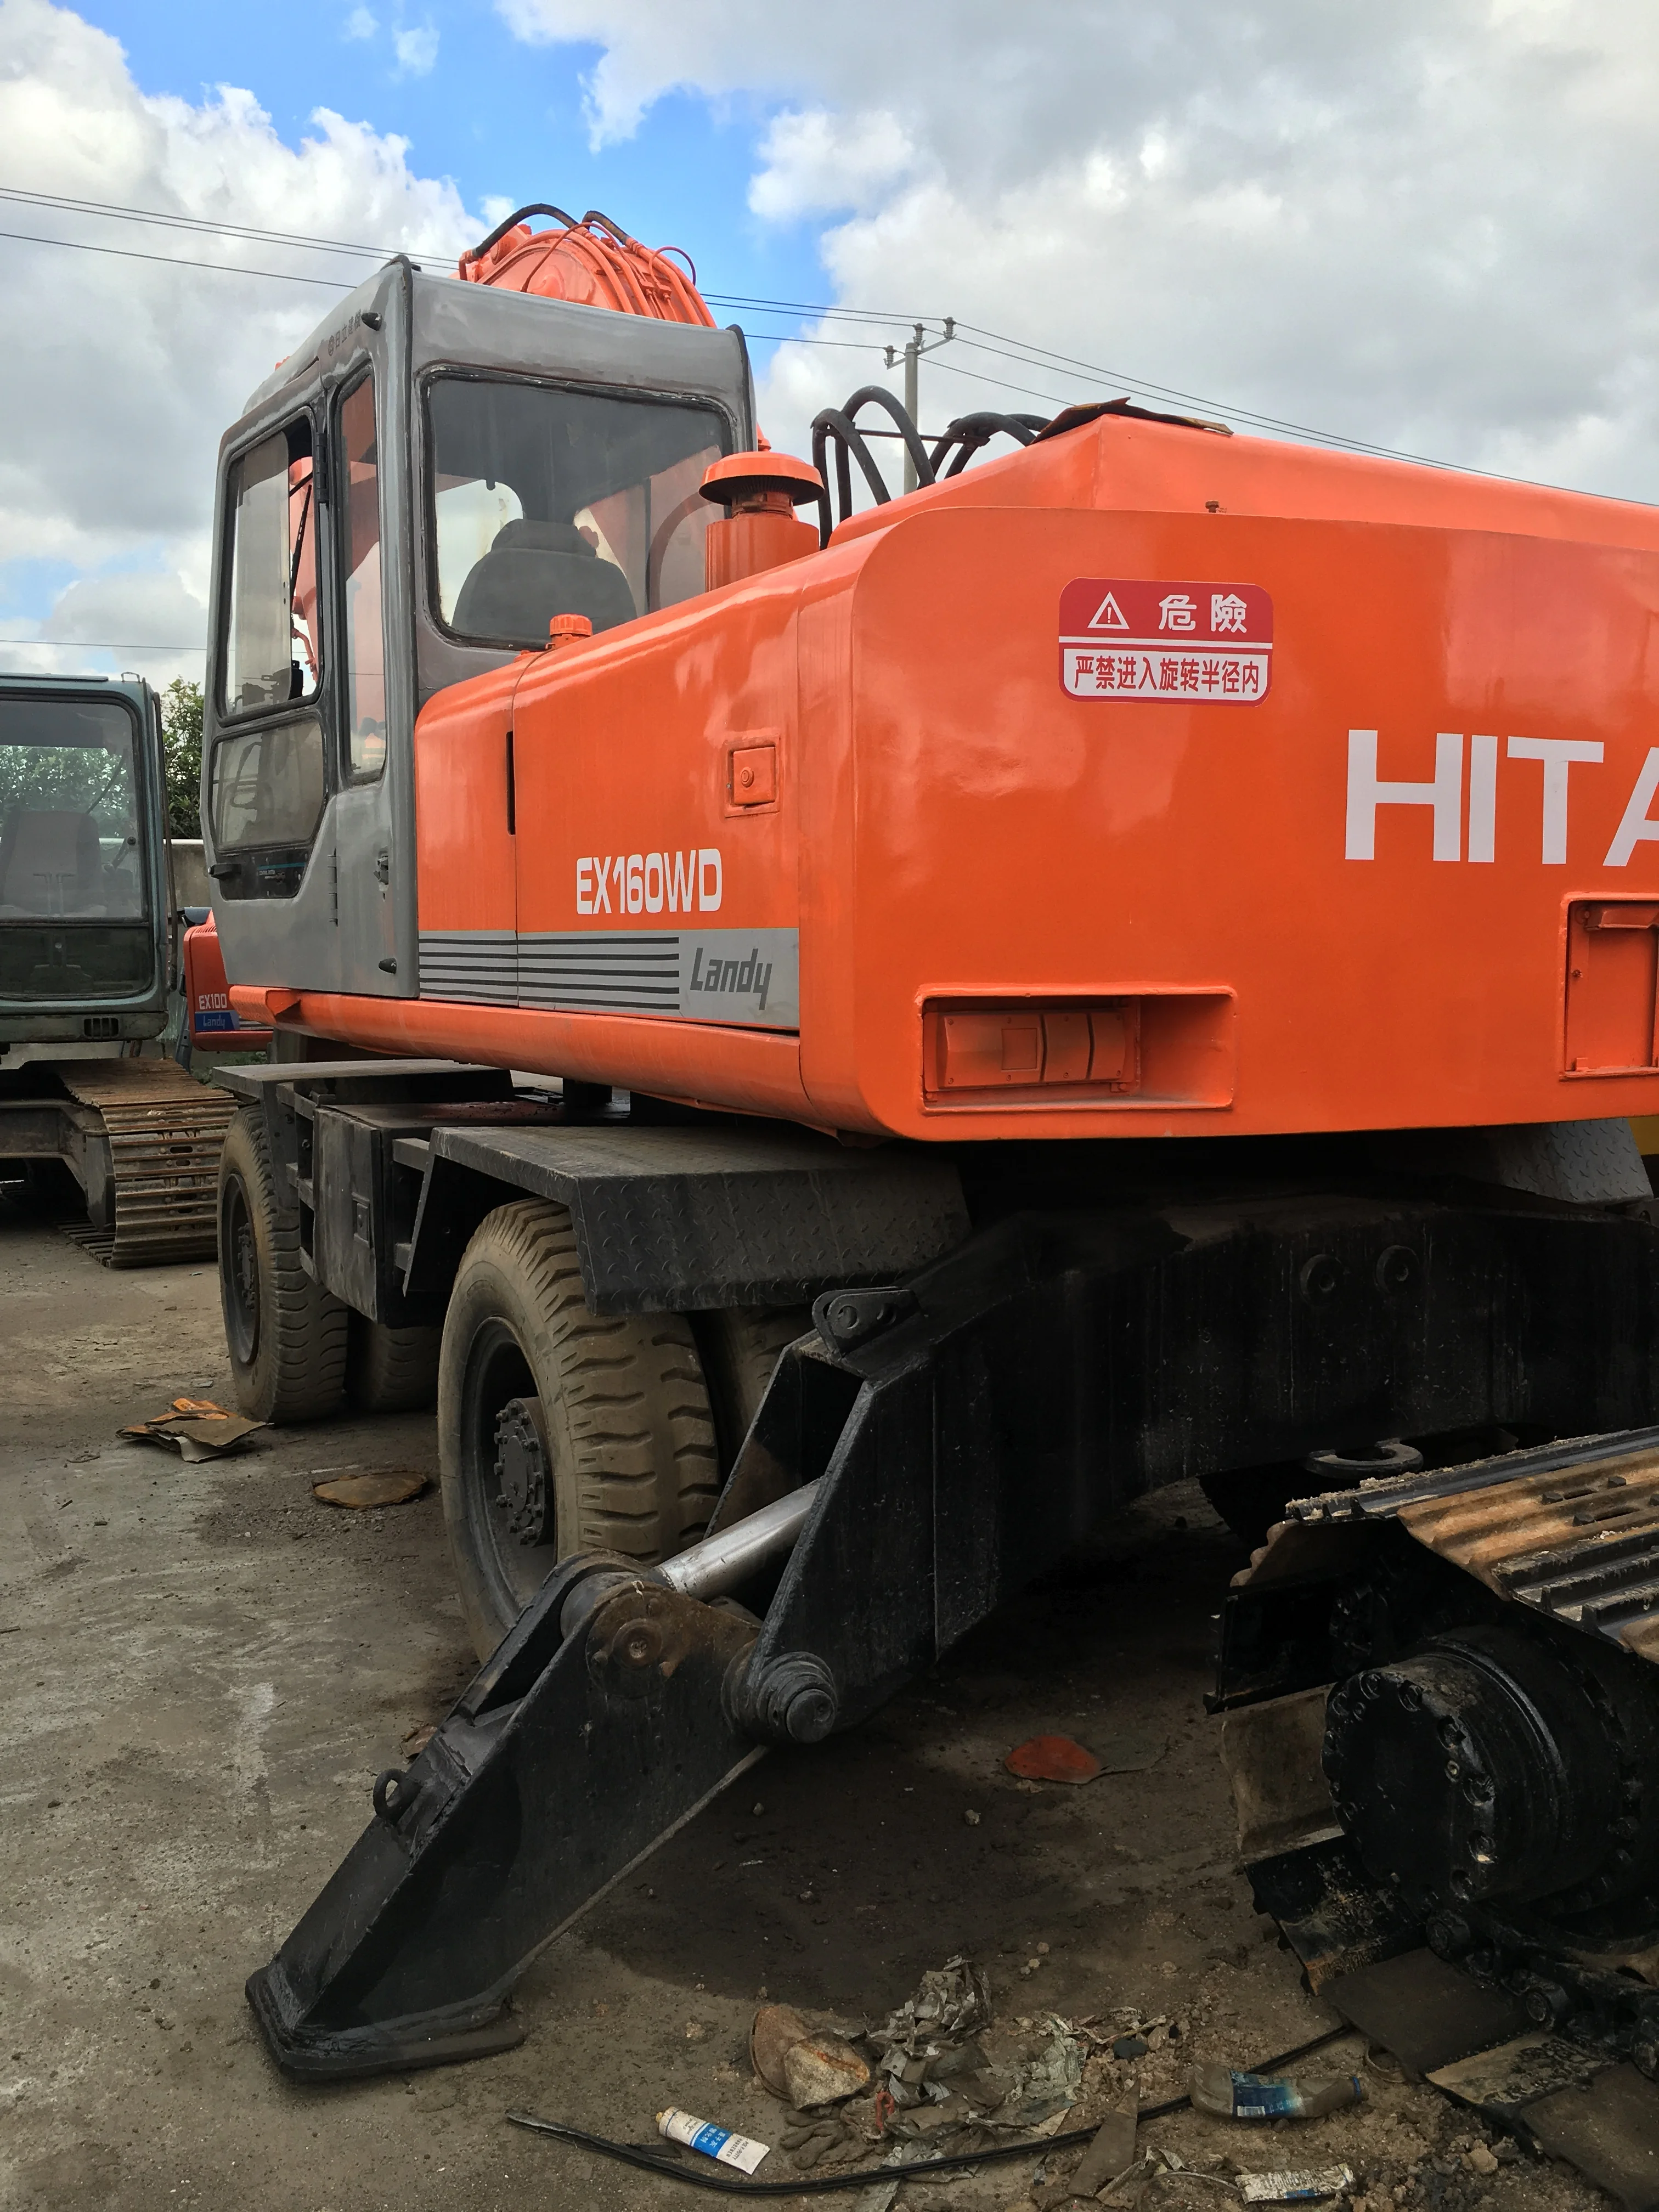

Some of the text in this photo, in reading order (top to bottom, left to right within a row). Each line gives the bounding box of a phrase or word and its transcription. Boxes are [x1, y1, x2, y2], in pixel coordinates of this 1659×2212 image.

[1158, 594, 1247, 633] 危險
[1074, 655, 1259, 693] 严禁进入旋转半径内
[577, 849, 723, 915] EX160WD
[690, 948, 772, 1011] Landy
[199, 994, 227, 1009] EX100
[203, 1014, 225, 1030] Landy
